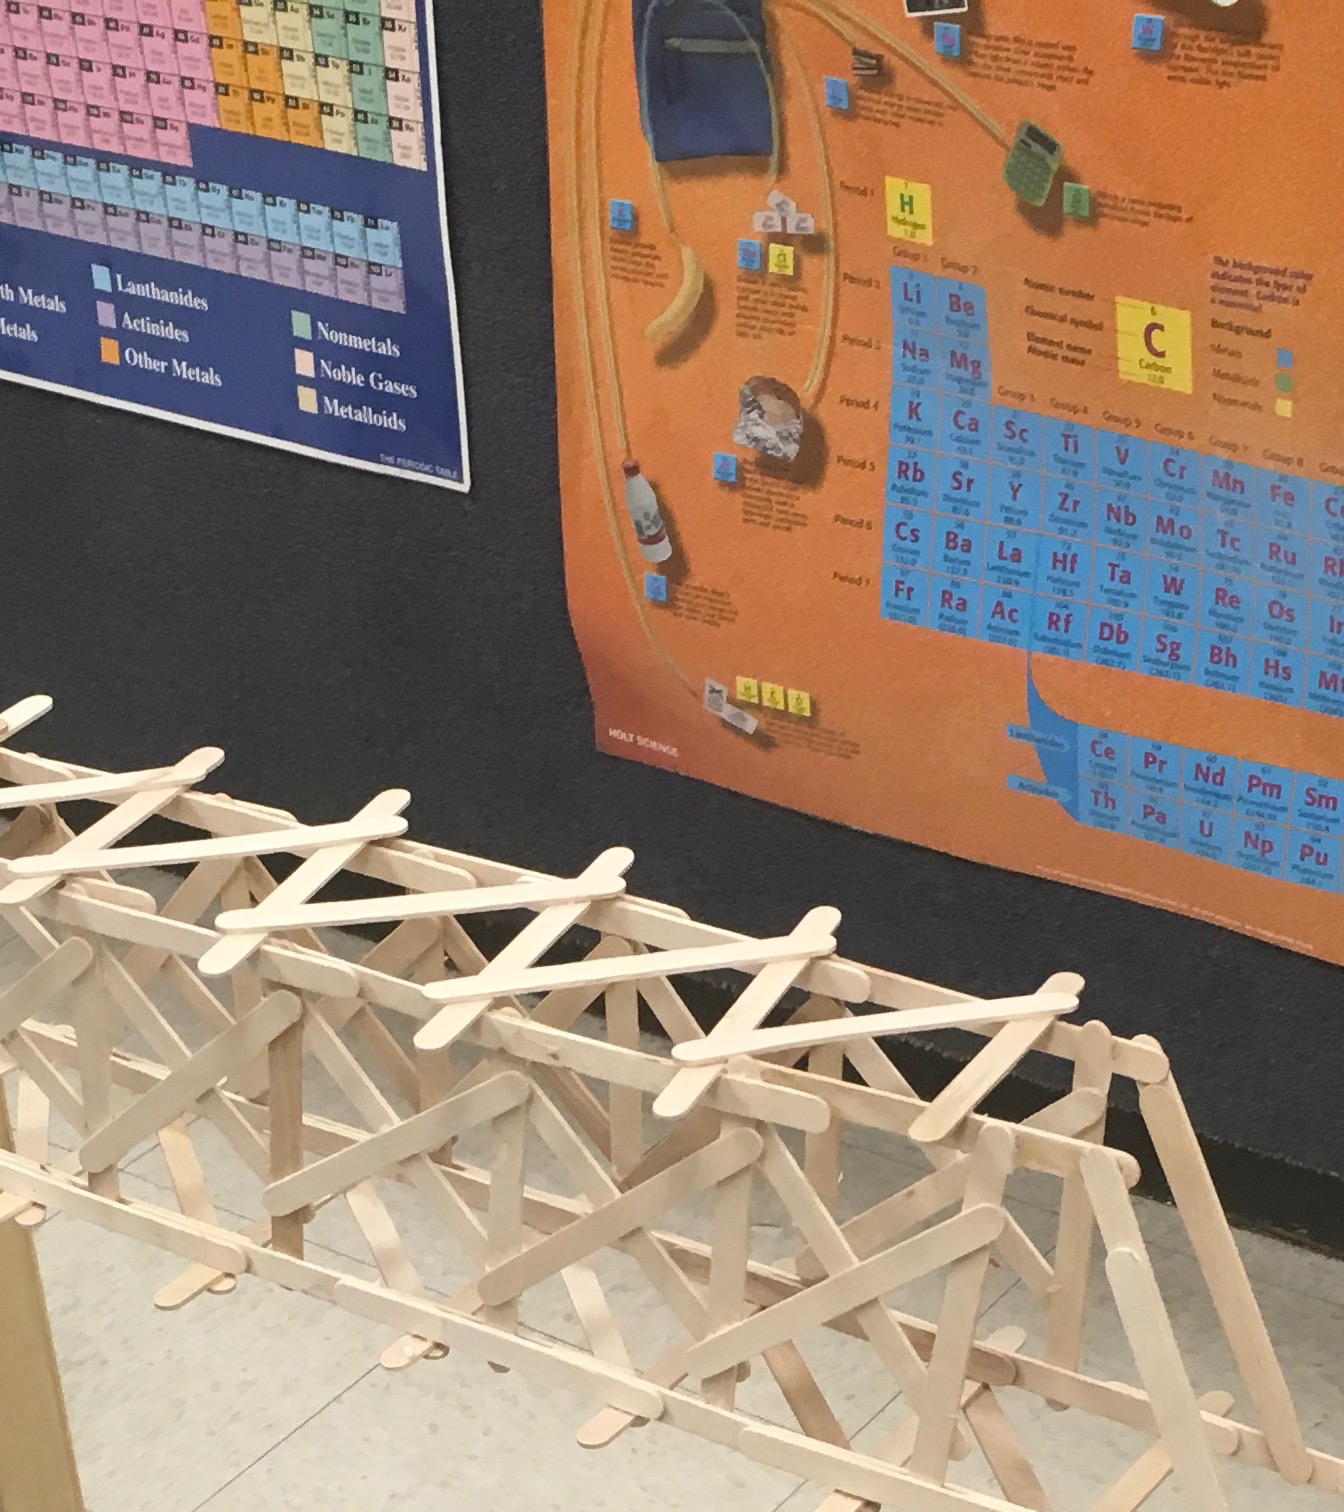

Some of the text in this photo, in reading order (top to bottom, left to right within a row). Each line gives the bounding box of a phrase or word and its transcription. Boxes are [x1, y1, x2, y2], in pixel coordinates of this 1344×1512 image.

[899, 193, 914, 215] H
[18, 287, 67, 314] Metals
[117, 273, 209, 311] Lanthanides
[902, 281, 922, 305] Li
[949, 293, 975, 315] Be
[121, 311, 190, 343] Actinides
[317, 321, 401, 358] Nonmetals
[902, 340, 928, 361] Na
[1144, 322, 1166, 358] C
[125, 347, 223, 387] Other Metals
[951, 352, 981, 377] Mg
[1139, 358, 1172, 374] Carbon
[320, 359, 418, 399] Noble Gases
[322, 395, 407, 433] Metalloids
[908, 402, 920, 419] K
[953, 410, 979, 432] Ca
[1004, 420, 1028, 442] Sc
[1061, 433, 1078, 454] Ti
[1116, 446, 1129, 465] V
[897, 460, 925, 482] Rb
[1163, 457, 1187, 477] Cr
[952, 470, 974, 492] Sr
[1010, 481, 1022, 501] Y
[1212, 470, 1245, 492] Mn
[1059, 493, 1079, 512] Zr
[1269, 484, 1295, 505] Fe
[1107, 503, 1136, 525] Nb
[895, 521, 920, 542] Cs
[1155, 516, 1192, 538] Mo
[945, 531, 971, 552] Ba
[1217, 529, 1240, 551] Tc
[998, 542, 1022, 562] La
[1052, 551, 1078, 574] Hf
[1269, 542, 1297, 565] Ru
[1109, 562, 1132, 584] Ta
[894, 580, 914, 600] Fr
[1163, 576, 1184, 595] W
[1215, 586, 1241, 607] Re
[941, 590, 967, 612] Ra
[991, 601, 1017, 622] Ac
[1268, 600, 1295, 622] Os
[1047, 611, 1071, 632] Rf
[1329, 614, 1344, 634] Ir
[1099, 622, 1129, 645] Db
[1156, 633, 1181, 662] Sg
[1209, 645, 1237, 666] Bh
[1263, 658, 1292, 680] Hs
[1090, 739, 1115, 760] Ce
[1144, 751, 1166, 772] Pr
[1194, 763, 1226, 786] Nd
[1247, 774, 1282, 797] Pm
[1093, 790, 1116, 809] Th
[1305, 787, 1338, 810] Sm
[1143, 804, 1166, 824] Pa
[1199, 820, 1214, 838] U
[1244, 831, 1274, 857] Np
[1300, 844, 1328, 866] Pu
